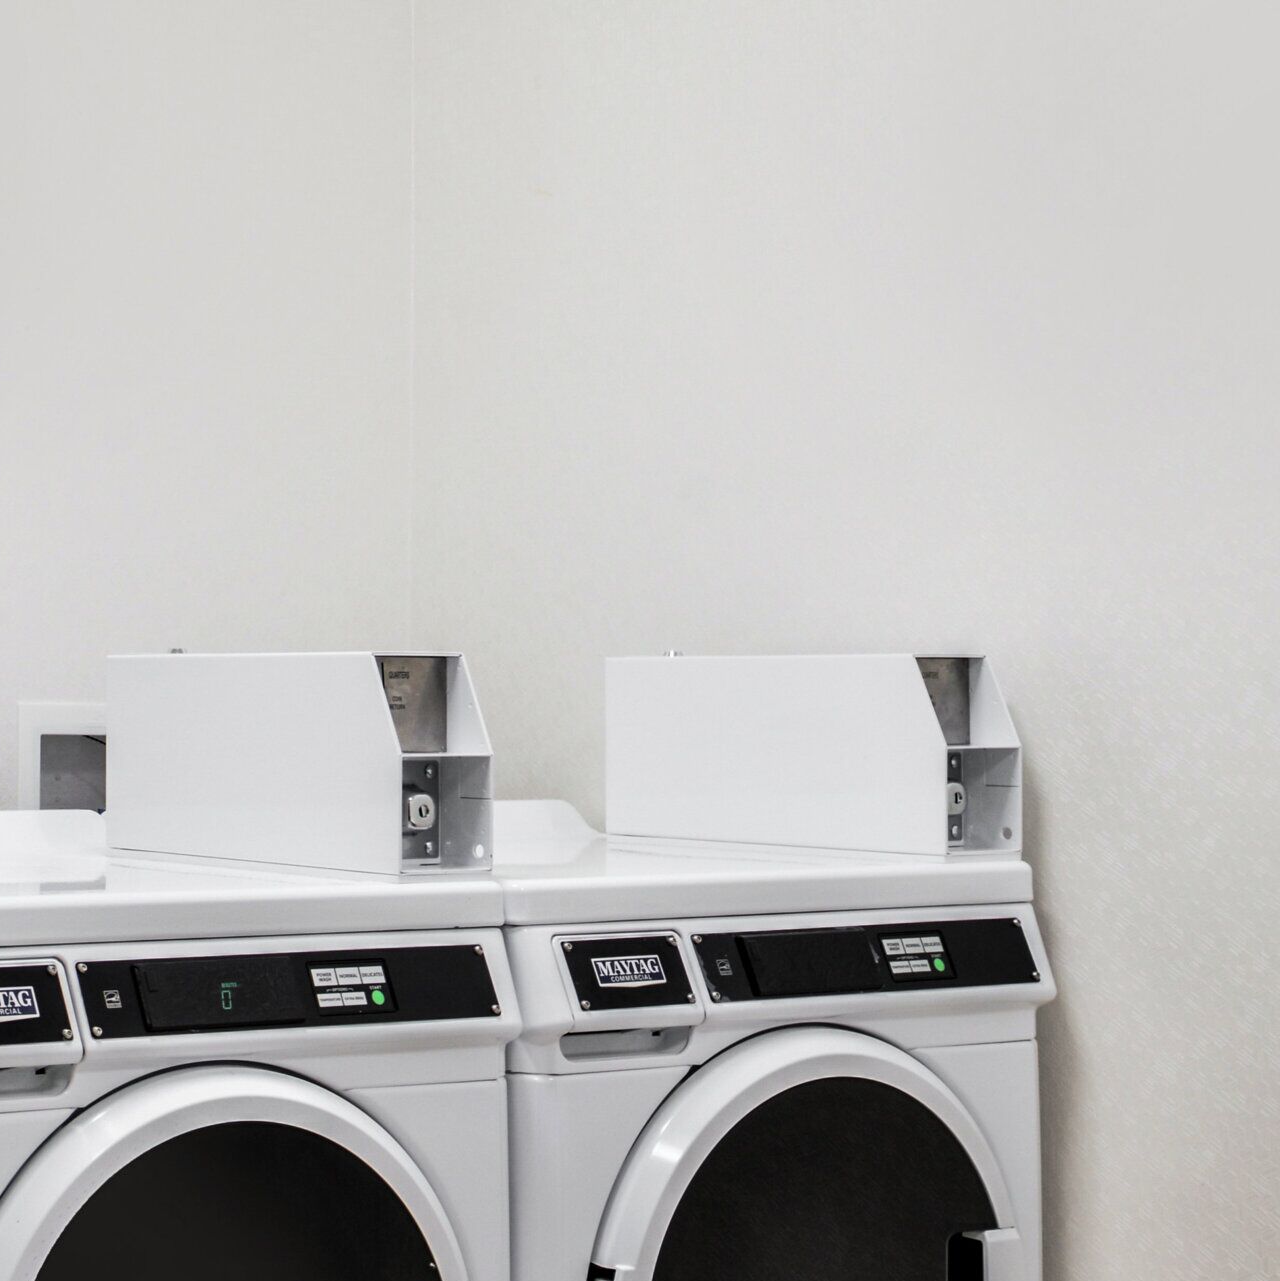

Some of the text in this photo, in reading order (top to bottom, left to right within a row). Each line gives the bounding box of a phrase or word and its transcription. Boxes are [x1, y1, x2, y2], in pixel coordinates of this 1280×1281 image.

[596, 958, 659, 977] MAYTAG
[610, 974, 652, 982] COMMERCIAL
[221, 990, 232, 1010] 0
